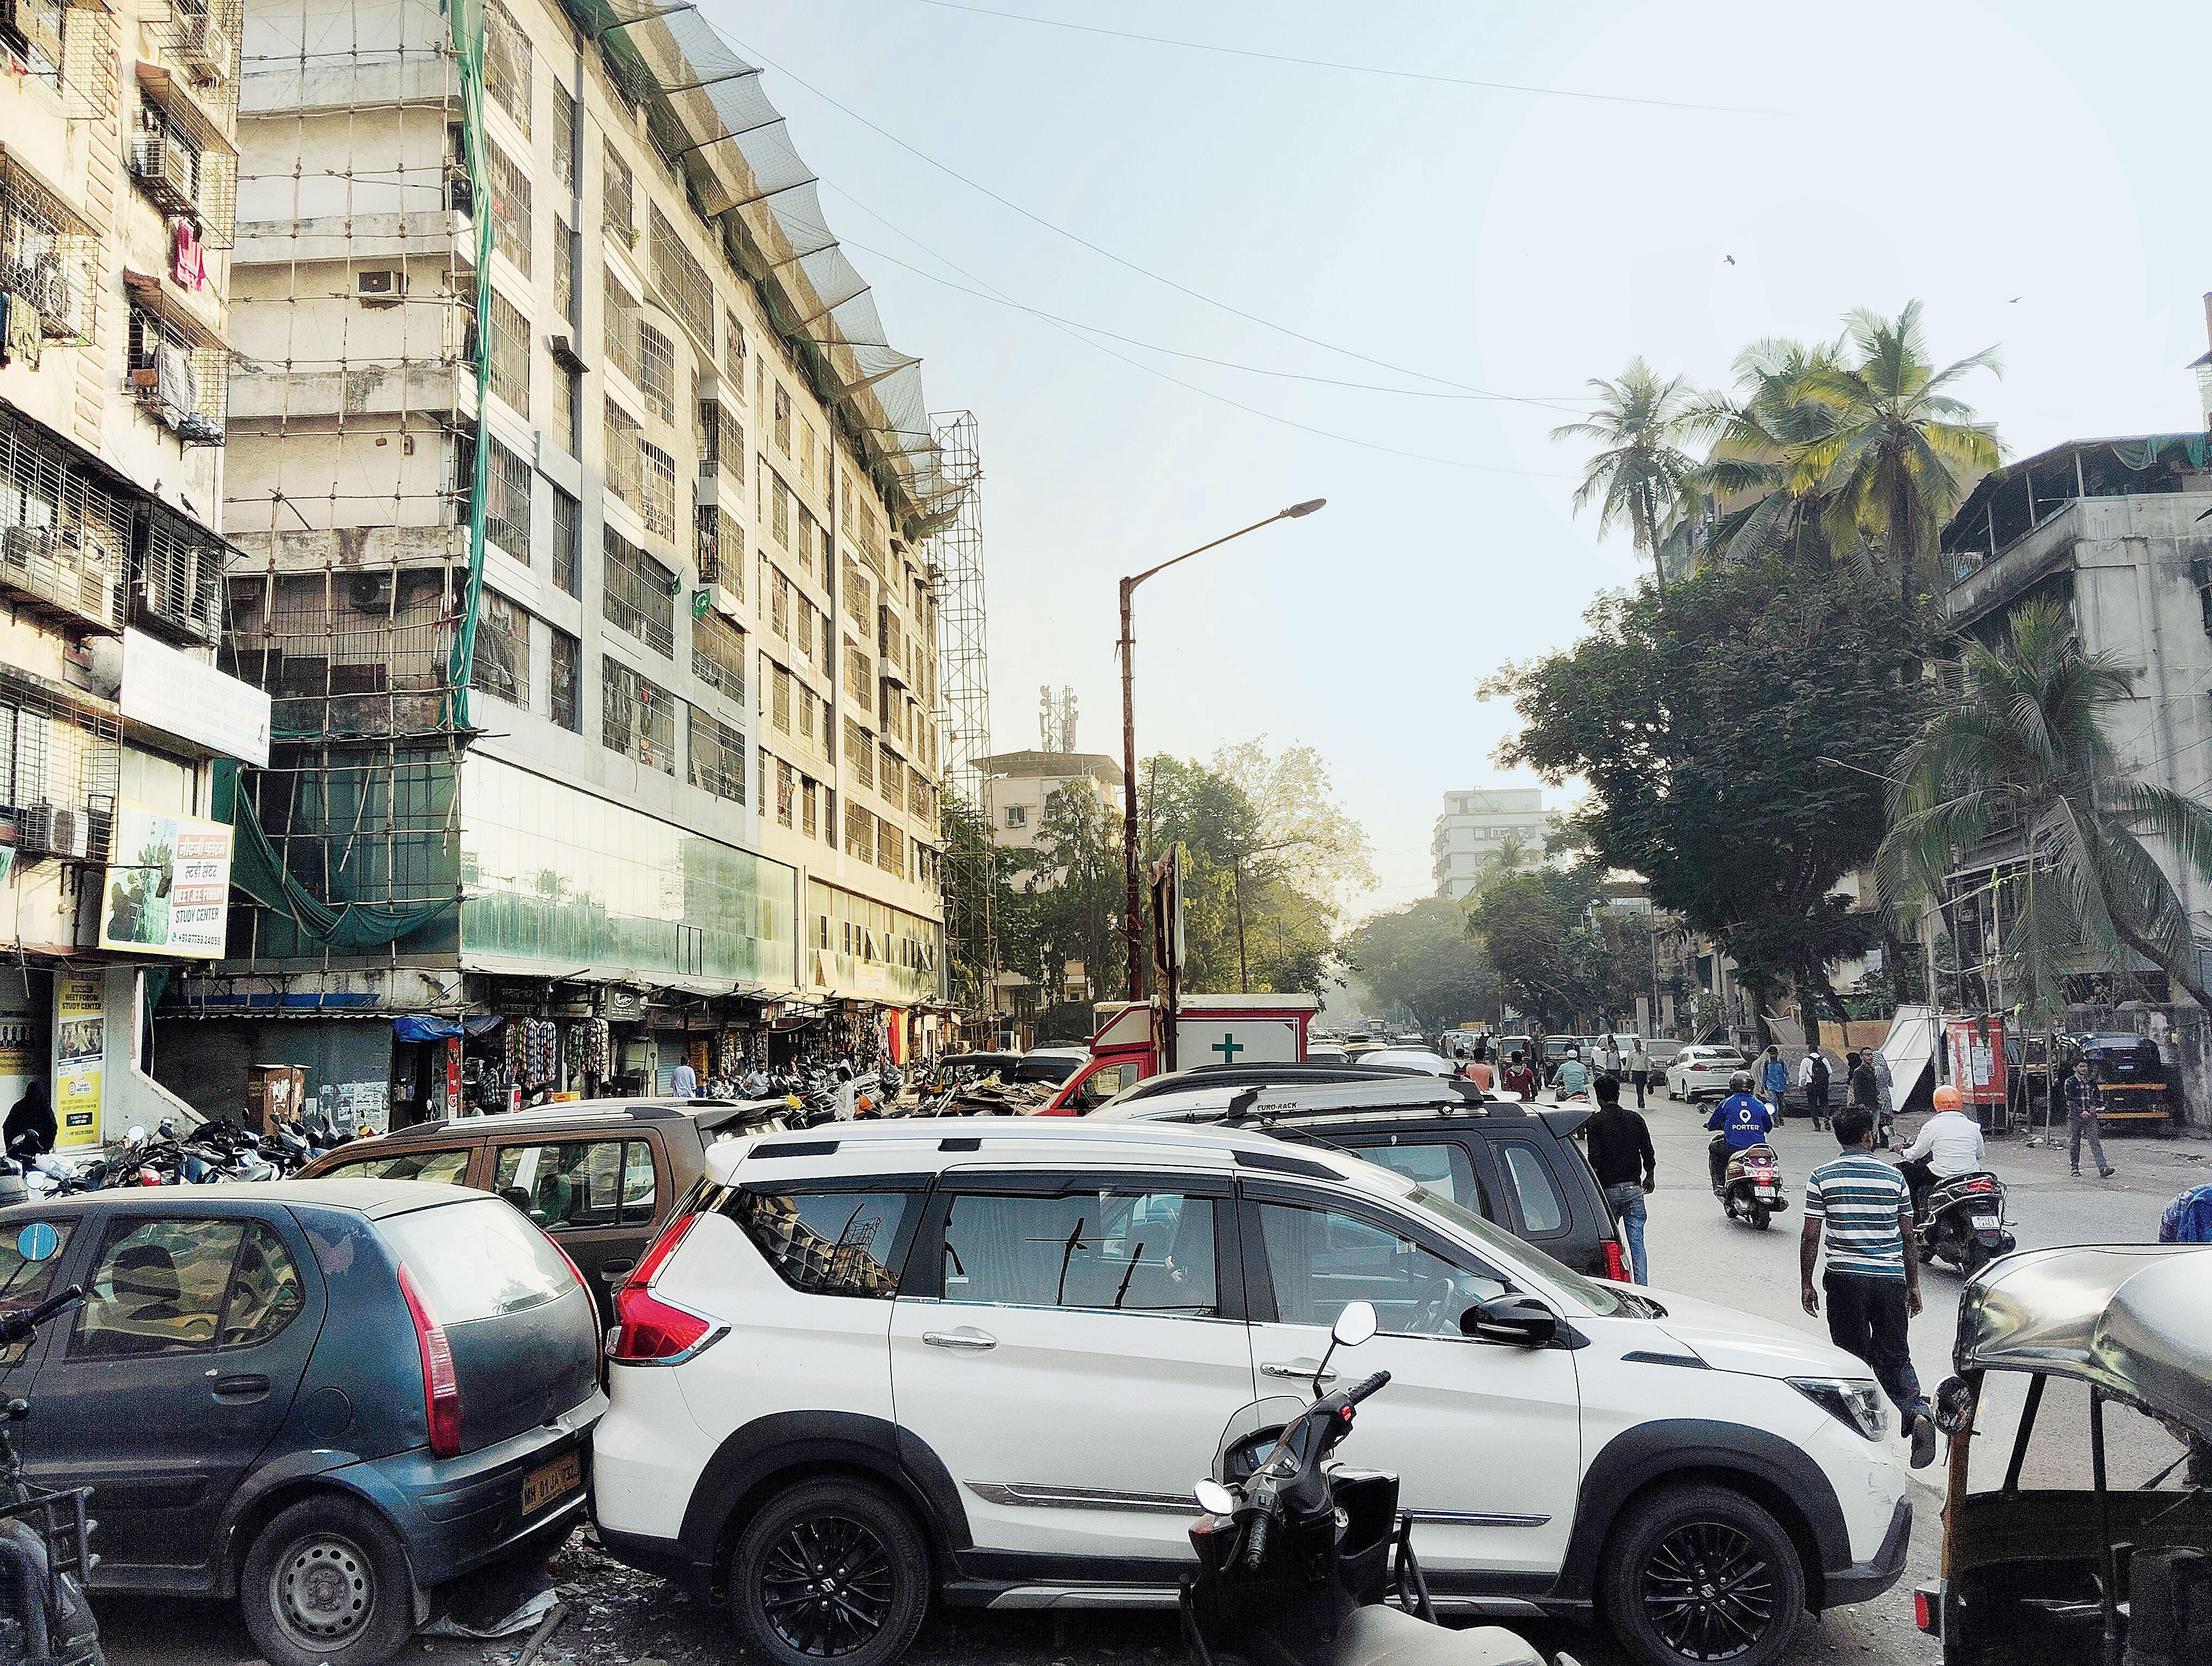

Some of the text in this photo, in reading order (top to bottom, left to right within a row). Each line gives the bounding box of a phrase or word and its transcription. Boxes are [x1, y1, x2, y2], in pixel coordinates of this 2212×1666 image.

[139, 653, 192, 688] ACHIEVERS
[137, 675, 192, 708] ACADEMY
[176, 908, 218, 923] STUDY CENTER
[1257, 1102, 1297, 1111] EURO-RACK
